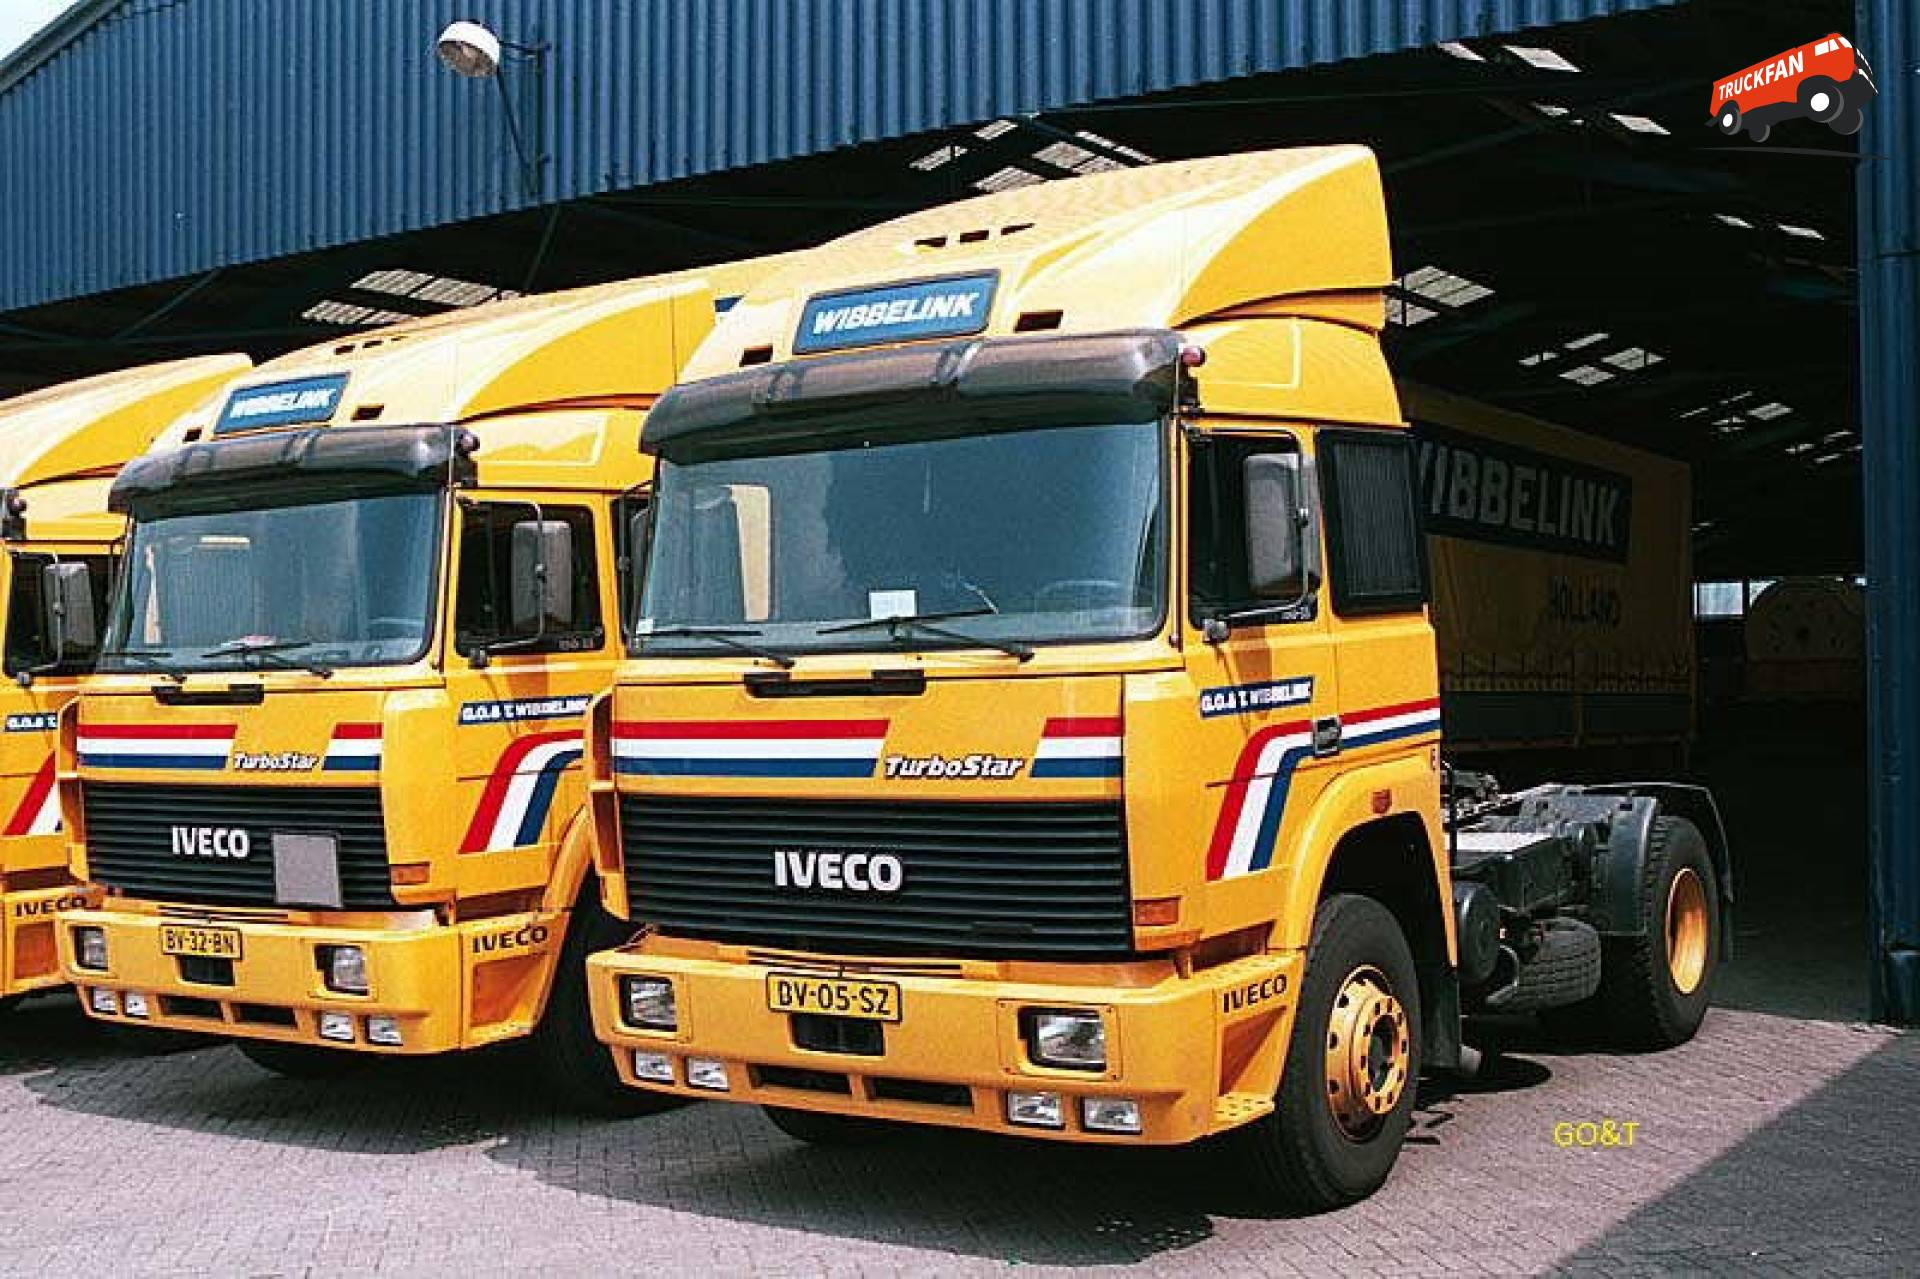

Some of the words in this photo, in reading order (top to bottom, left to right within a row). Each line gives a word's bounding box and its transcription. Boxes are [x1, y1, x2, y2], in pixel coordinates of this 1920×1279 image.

[812, 292, 980, 335] WIBBELINK
[233, 752, 320, 770] TurboStar
[884, 755, 1024, 779] TurboStar
[171, 827, 250, 858] IVECO
[774, 850, 903, 892] IVECO
[15, 895, 87, 917] IVECO
[165, 929, 235, 953] BV-32-BN
[472, 925, 549, 954] IVECO
[1222, 973, 1288, 1013] IVECO
